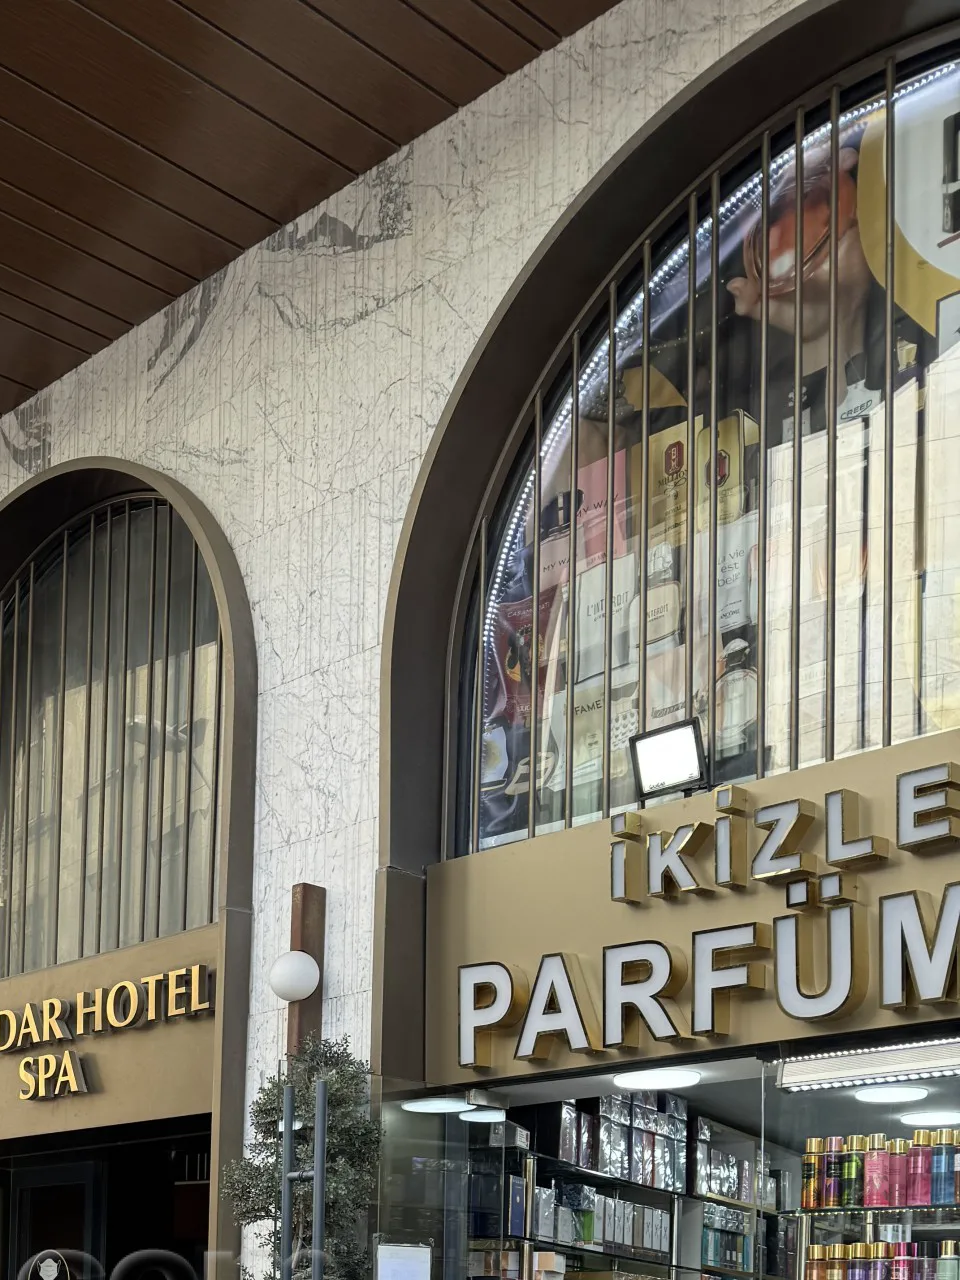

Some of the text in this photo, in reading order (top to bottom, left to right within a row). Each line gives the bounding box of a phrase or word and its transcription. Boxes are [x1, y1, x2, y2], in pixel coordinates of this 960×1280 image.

[720, 562, 739, 573] est
[587, 591, 629, 617] L'INTRDIT
[574, 700, 603, 715] FAME
[457, 872, 960, 1068] PARFÜM
[76, 964, 211, 1035] HOTEL
[18, 1050, 81, 1101] SPA
